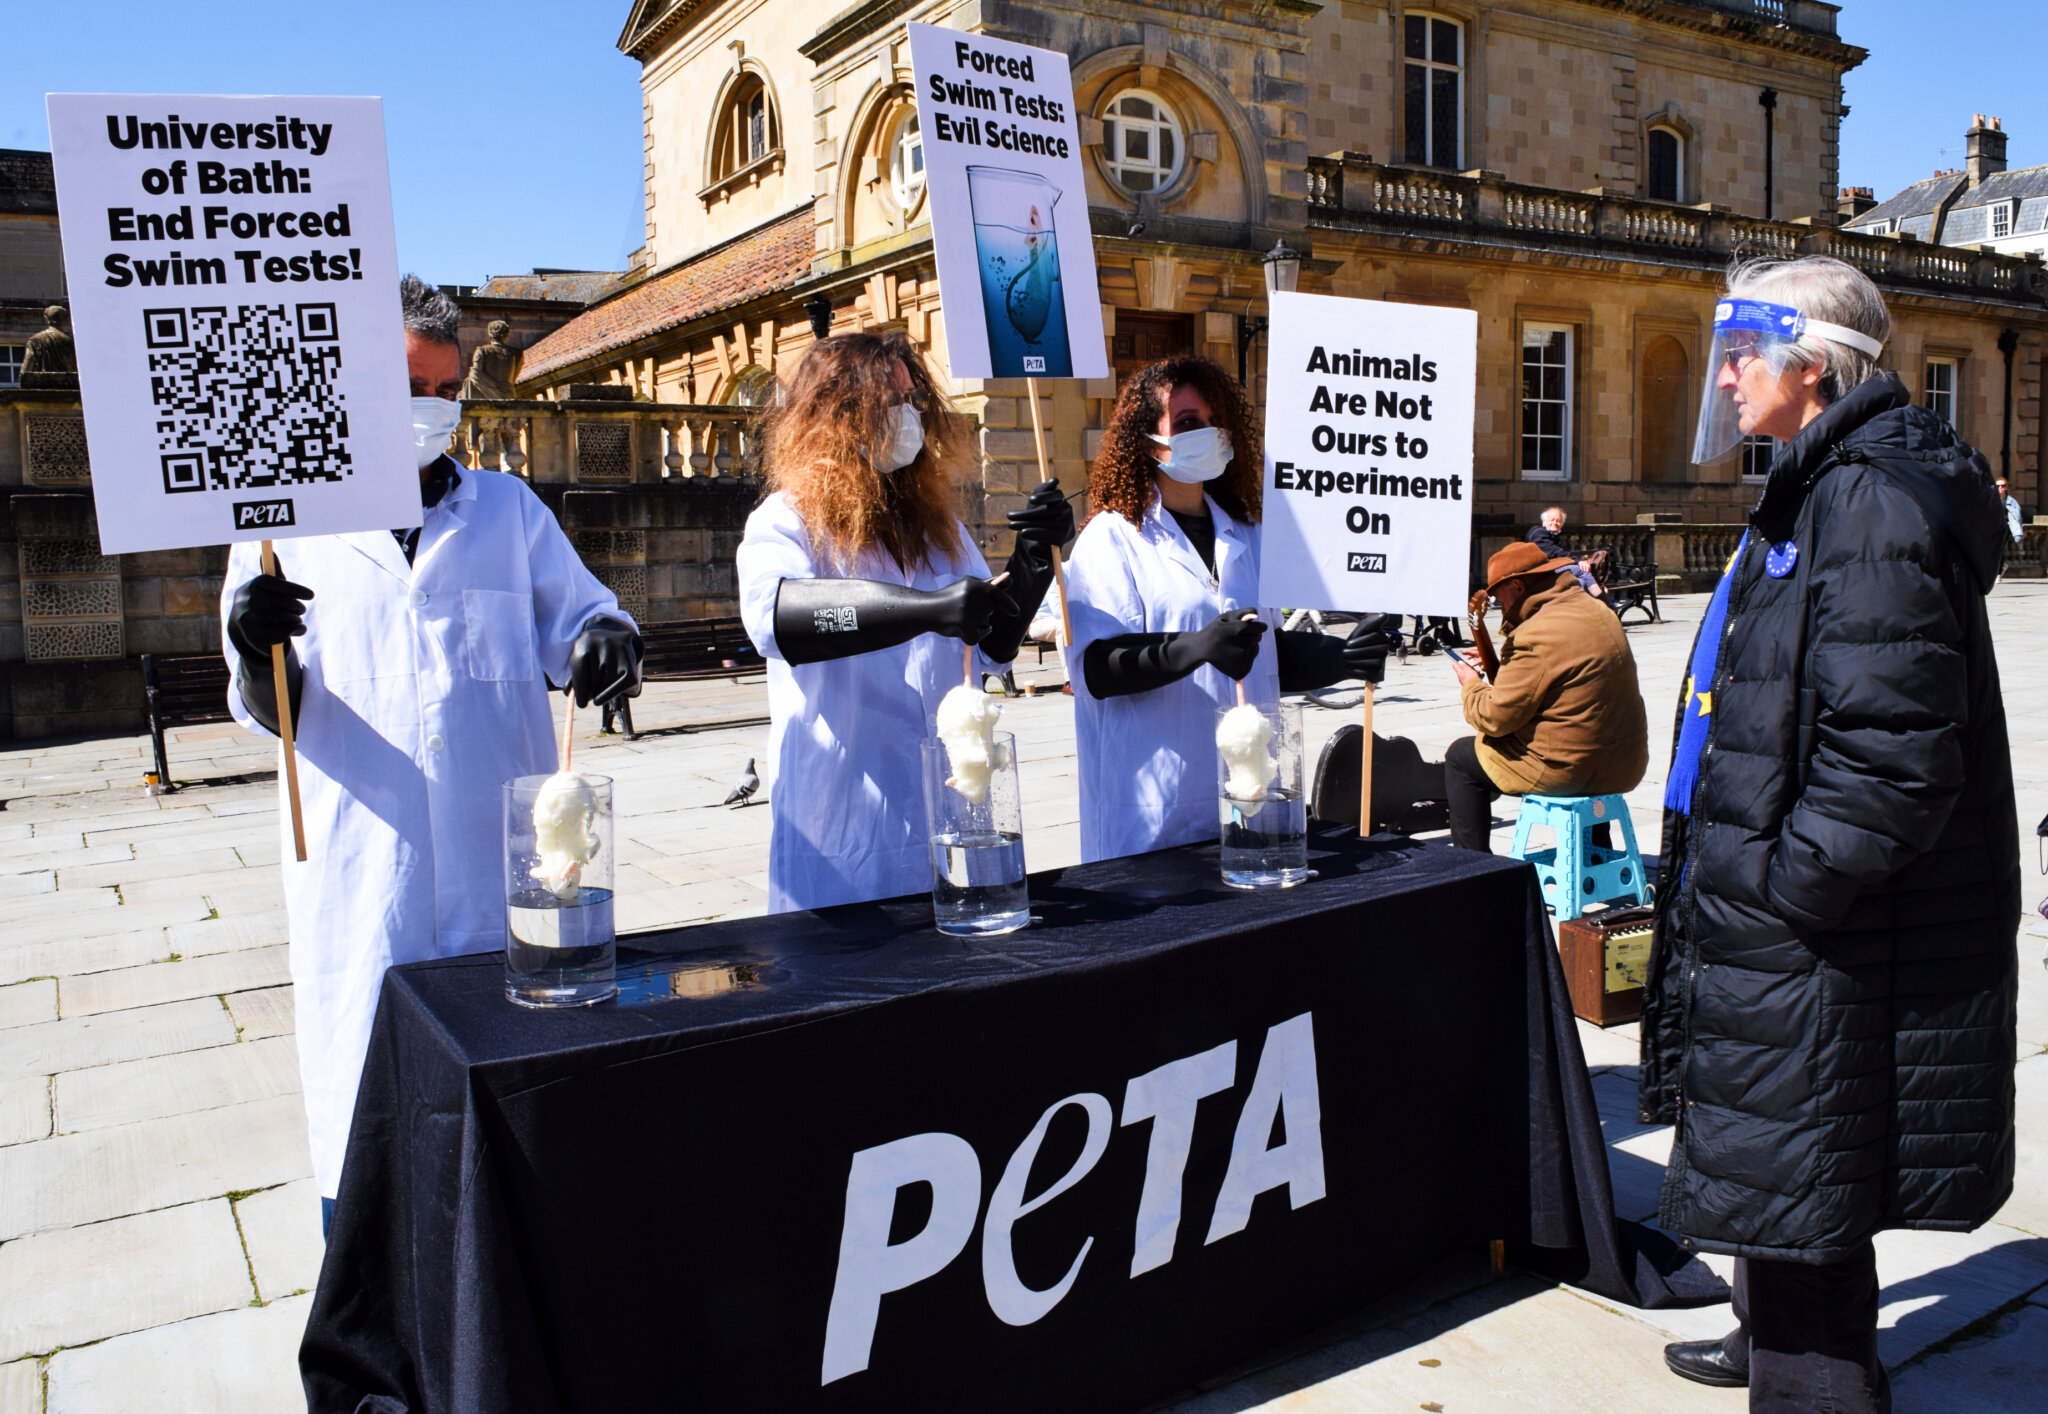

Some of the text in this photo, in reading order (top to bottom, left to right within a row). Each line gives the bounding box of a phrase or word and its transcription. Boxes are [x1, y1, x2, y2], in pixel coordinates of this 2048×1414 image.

[955, 40, 1035, 83] Forced
[930, 73, 1065, 123] Swim Tests:
[106, 114, 333, 156] University
[934, 111, 1069, 159] Evil Science
[141, 159, 312, 196] of Bath:
[107, 203, 351, 242] End Forced
[103, 247, 363, 288] Swim Tests!
[1306, 346, 1437, 383] Animals
[1308, 385, 1433, 421] Are Not
[1311, 424, 1429, 460] Ours to
[1274, 461, 1463, 501] Experiment
[1345, 505, 1391, 535] On
